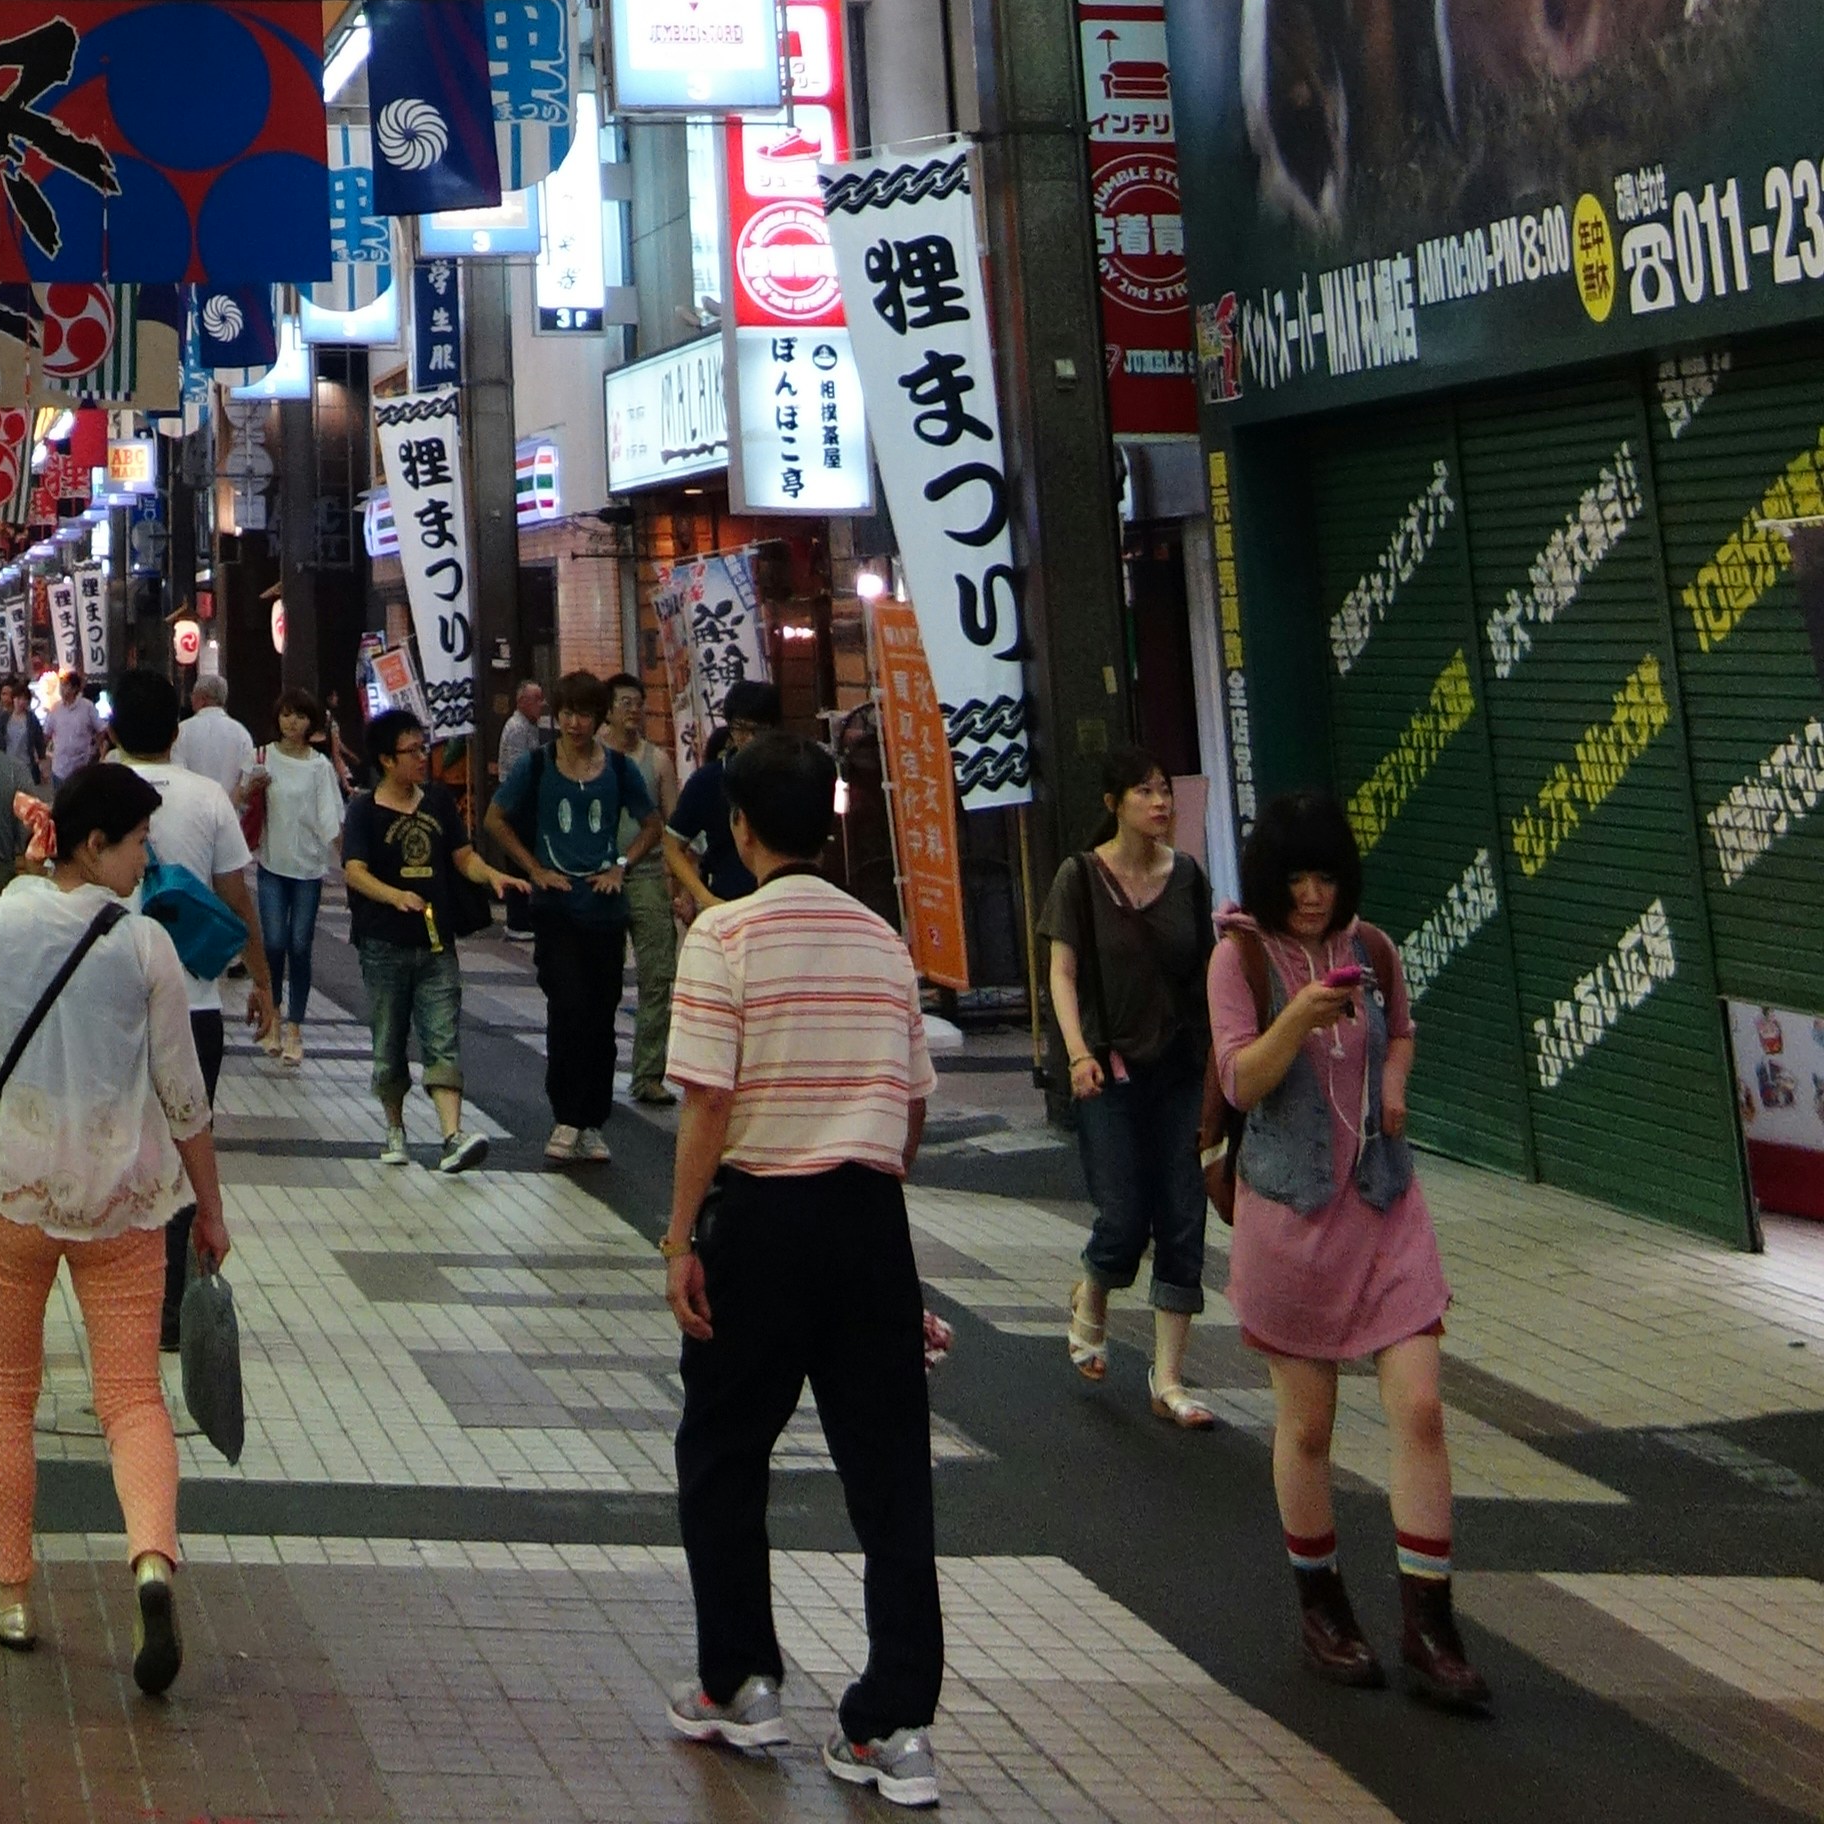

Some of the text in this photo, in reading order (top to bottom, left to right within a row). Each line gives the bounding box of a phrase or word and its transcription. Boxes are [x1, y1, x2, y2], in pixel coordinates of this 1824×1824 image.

[1672, 155, 1824, 303] 011-23
[427, 259, 456, 370] 学生服
[556, 308, 587, 329] 3F
[111, 466, 145, 478] MART
[112, 449, 144, 465] ABC
[771, 337, 805, 500] ぽんぽこ亭
[864, 234, 1030, 662] 狸まつり
[398, 436, 472, 663] 狸まつり
[81, 576, 106, 668] 狸まつり
